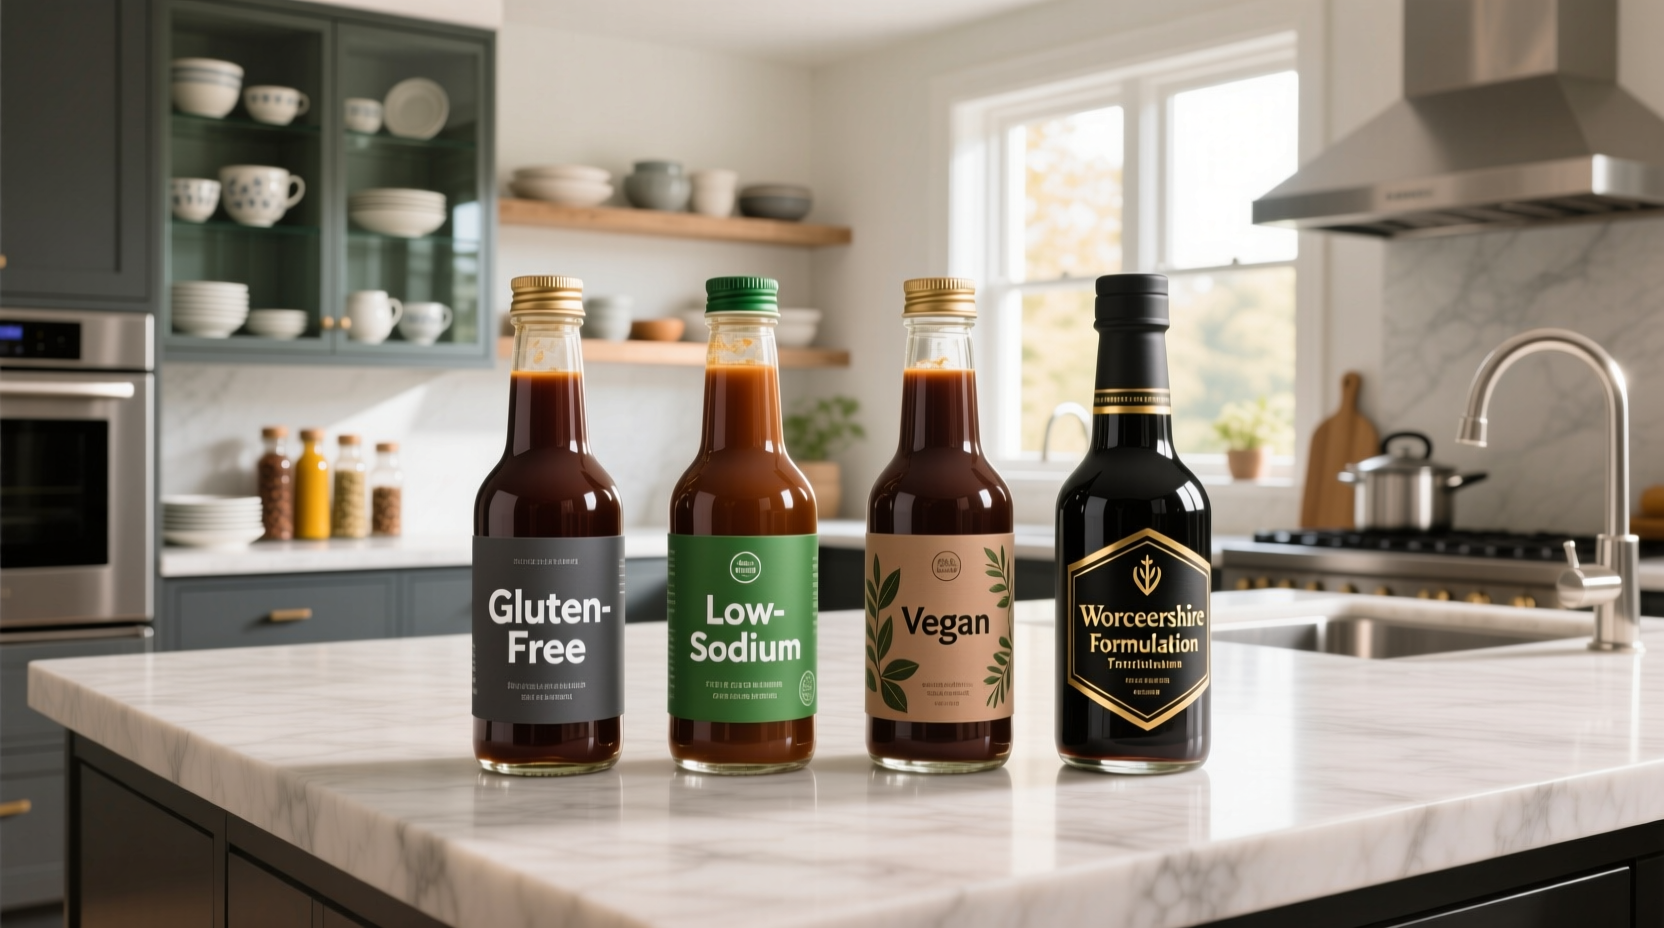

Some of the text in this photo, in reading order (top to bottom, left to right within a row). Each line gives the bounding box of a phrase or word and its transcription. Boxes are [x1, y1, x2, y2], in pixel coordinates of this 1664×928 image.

[489, 589, 611, 624] Gluten-
[706, 595, 785, 625] Low-
[1079, 604, 1205, 628] Worceershire
[902, 606, 990, 645] Vegan
[508, 631, 586, 664] Free
[690, 631, 801, 662] Sodium
[1090, 633, 1199, 653] Formulation
